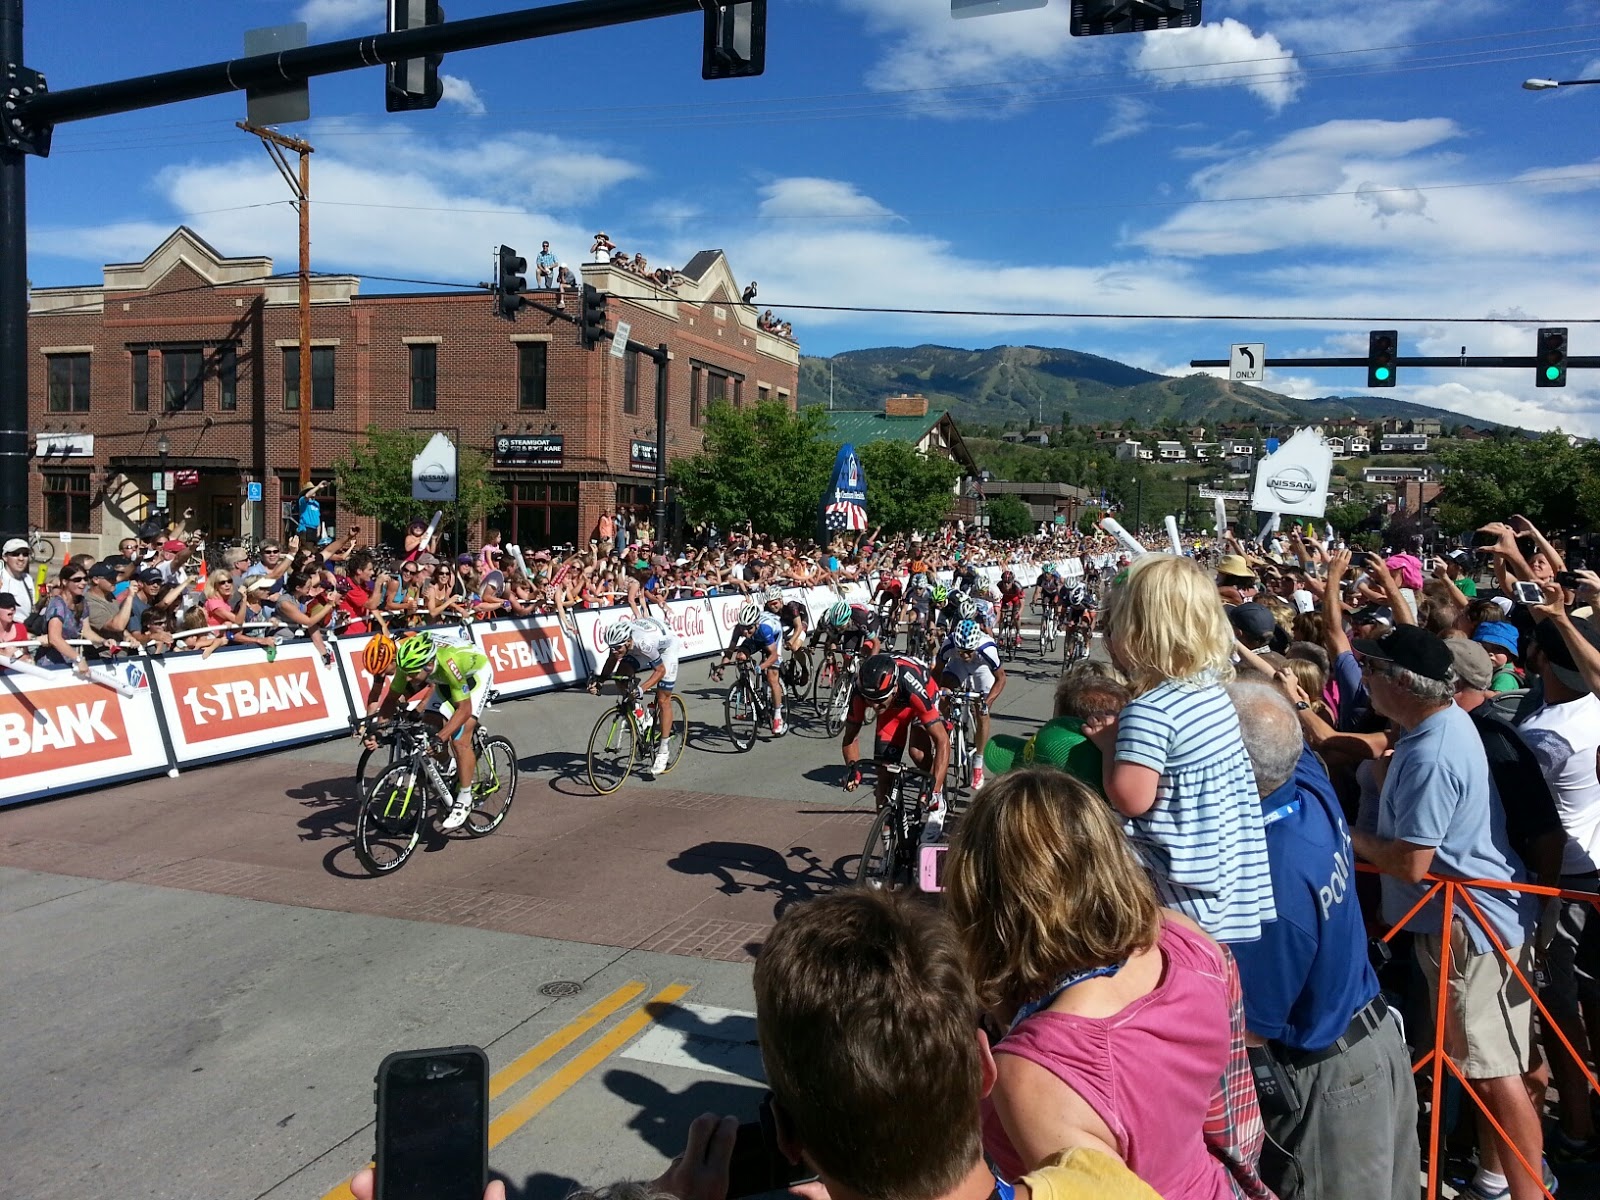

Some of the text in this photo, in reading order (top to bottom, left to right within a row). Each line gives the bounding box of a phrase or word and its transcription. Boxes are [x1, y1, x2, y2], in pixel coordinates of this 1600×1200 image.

[1235, 371, 1256, 379] ONLY
[1271, 479, 1312, 490] NISSAN
[489, 636, 566, 672] 1STBANK
[183, 671, 319, 726] 1STBANK
